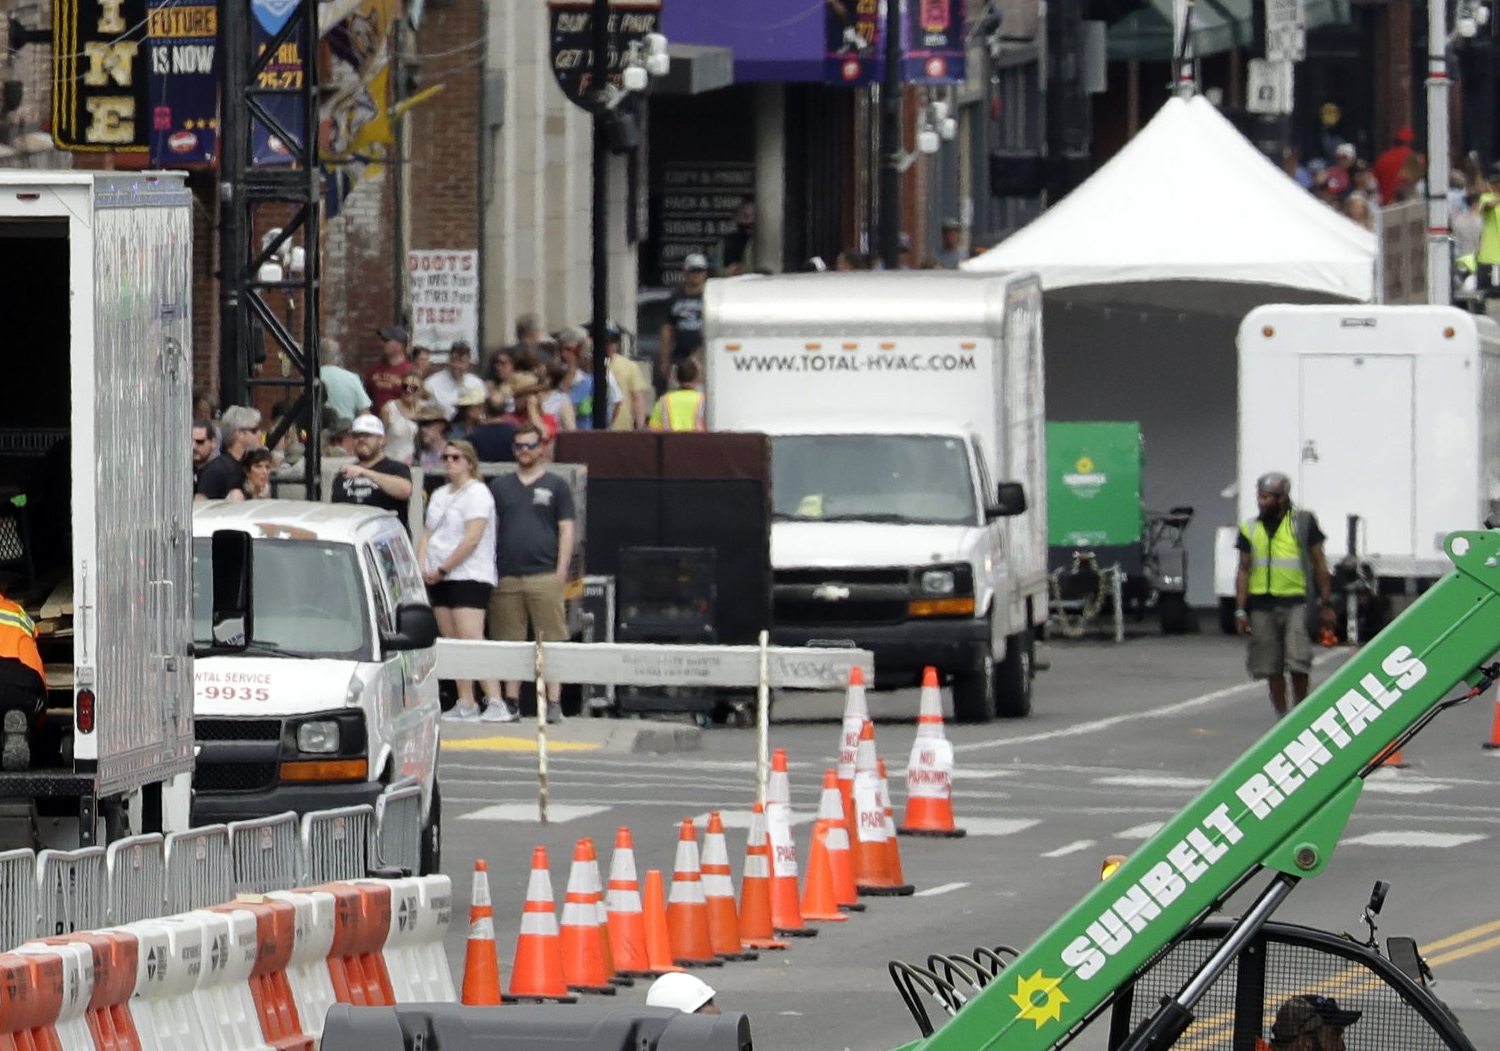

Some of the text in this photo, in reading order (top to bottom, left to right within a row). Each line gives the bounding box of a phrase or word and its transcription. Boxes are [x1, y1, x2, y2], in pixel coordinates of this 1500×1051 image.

[152, 7, 215, 37] FUTURE
[153, 45, 216, 74] IS NOW
[732, 354, 977, 372] WWW.TOTAL-HVAC.COM
[194, 671, 272, 684] NTAL SERVICE
[196, 685, 270, 702] -9935
[919, 750, 936, 766] NO
[908, 769, 949, 786] PARKING
[1060, 645, 1428, 981] SUNBELT RENTALS
